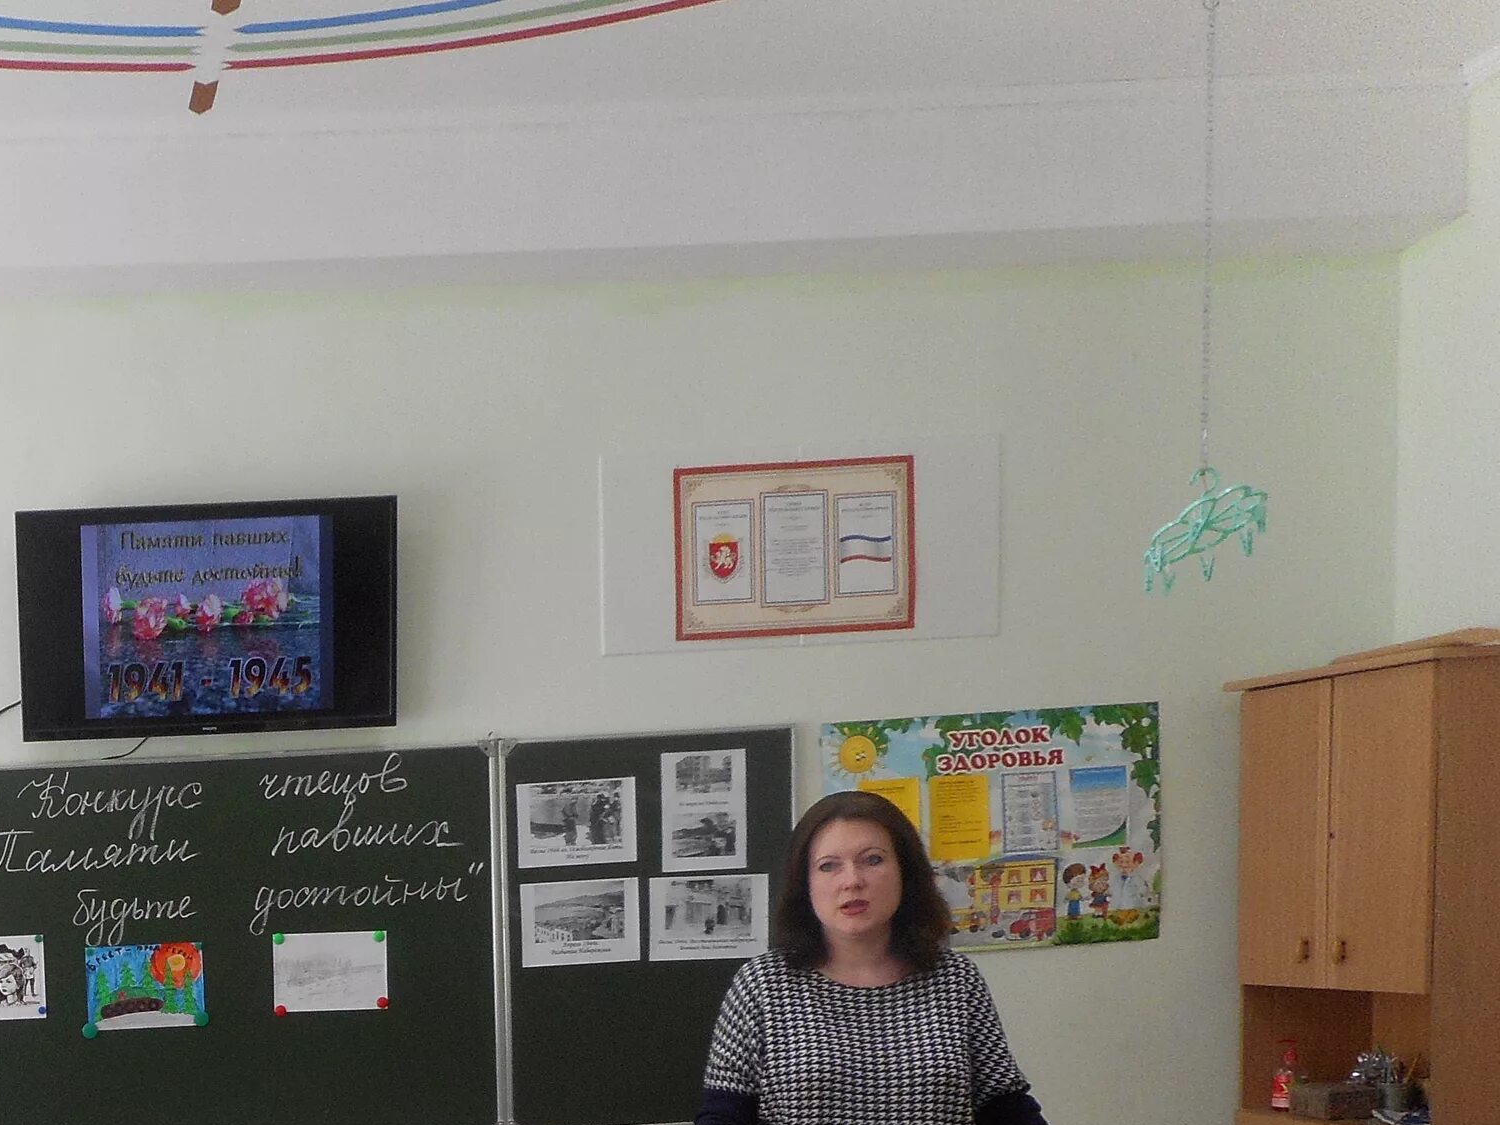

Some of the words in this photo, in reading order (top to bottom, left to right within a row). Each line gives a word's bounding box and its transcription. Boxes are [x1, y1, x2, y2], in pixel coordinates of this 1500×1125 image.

[120, 530, 204, 550] Памяти
[212, 530, 288, 548] павших
[115, 563, 185, 591] будьте
[191, 556, 302, 586] достойны!
[107, 659, 186, 703] 1941
[228, 655, 312, 699] 1945
[948, 727, 1050, 748] УГОЛОК
[937, 749, 1064, 772] ЗДОРОВЬЯ
[16, 771, 202, 841] Конкурс
[259, 752, 408, 805] чтецов
[271, 802, 464, 857] павших
[72, 888, 197, 947] будьте
